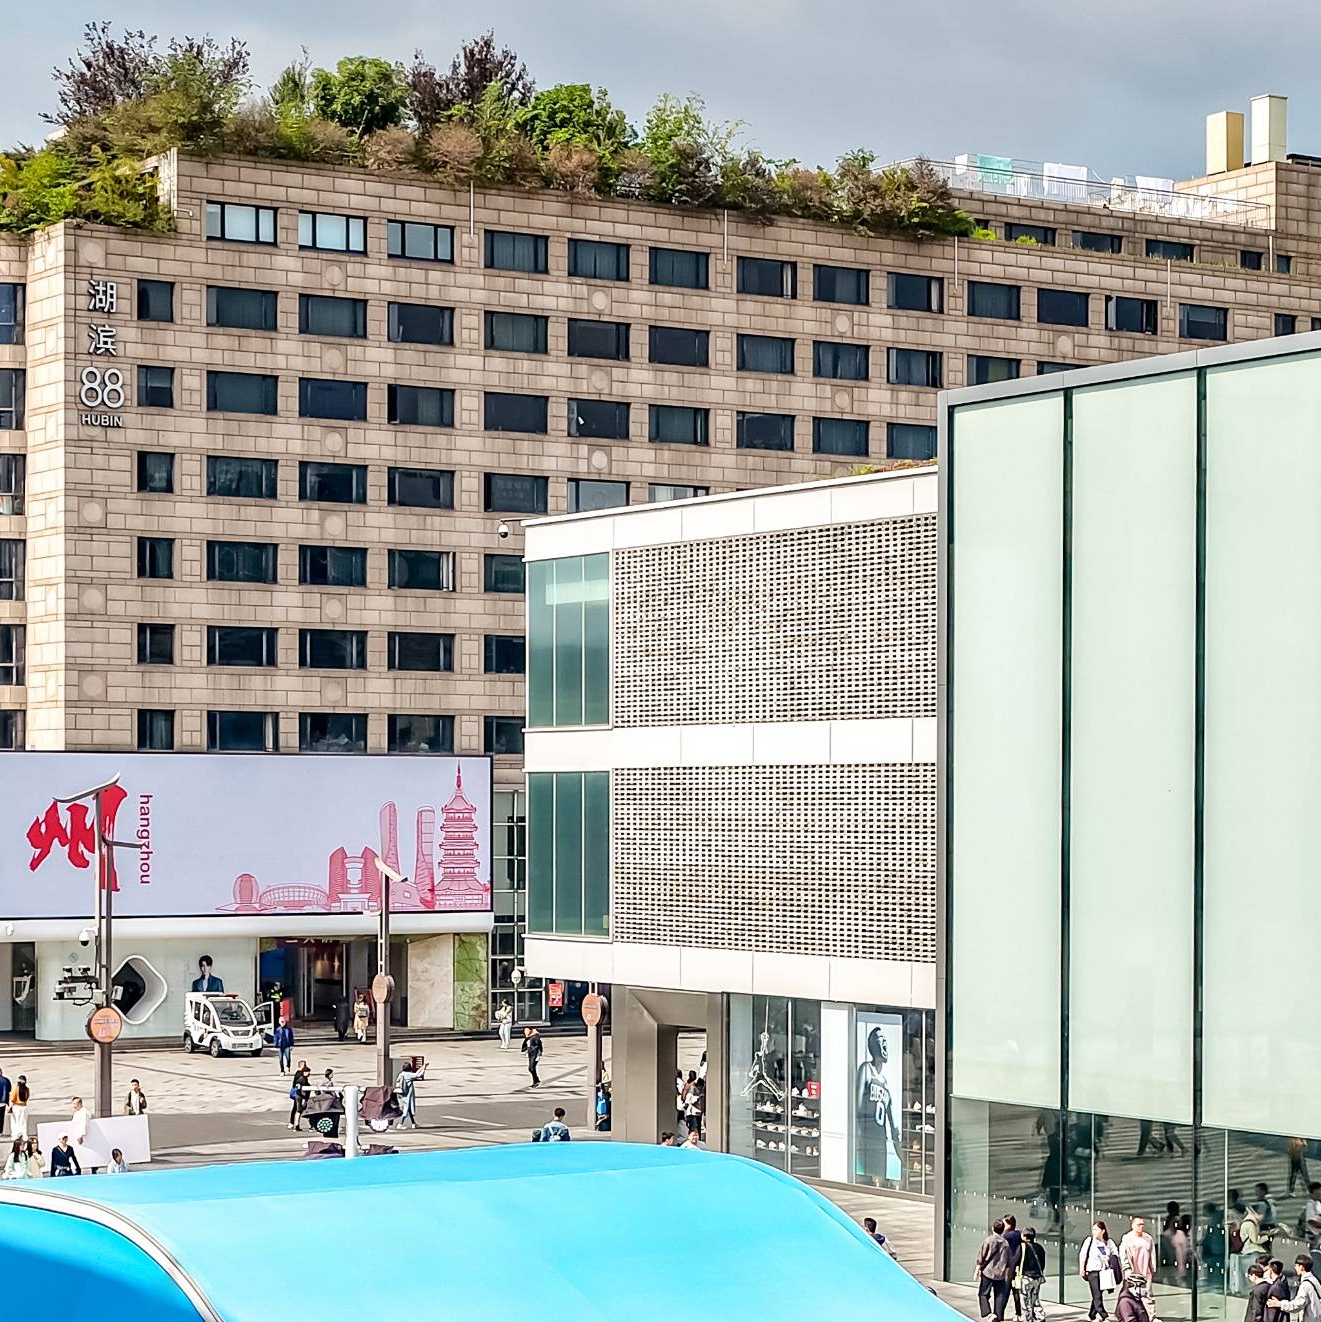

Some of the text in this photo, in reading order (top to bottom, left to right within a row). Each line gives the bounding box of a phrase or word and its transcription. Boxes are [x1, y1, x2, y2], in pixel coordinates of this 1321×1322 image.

[87, 279, 117, 357] 湖滨
[80, 366, 125, 408] 88
[81, 415, 123, 428] HUBIN
[137, 794, 153, 884] hangzhou
